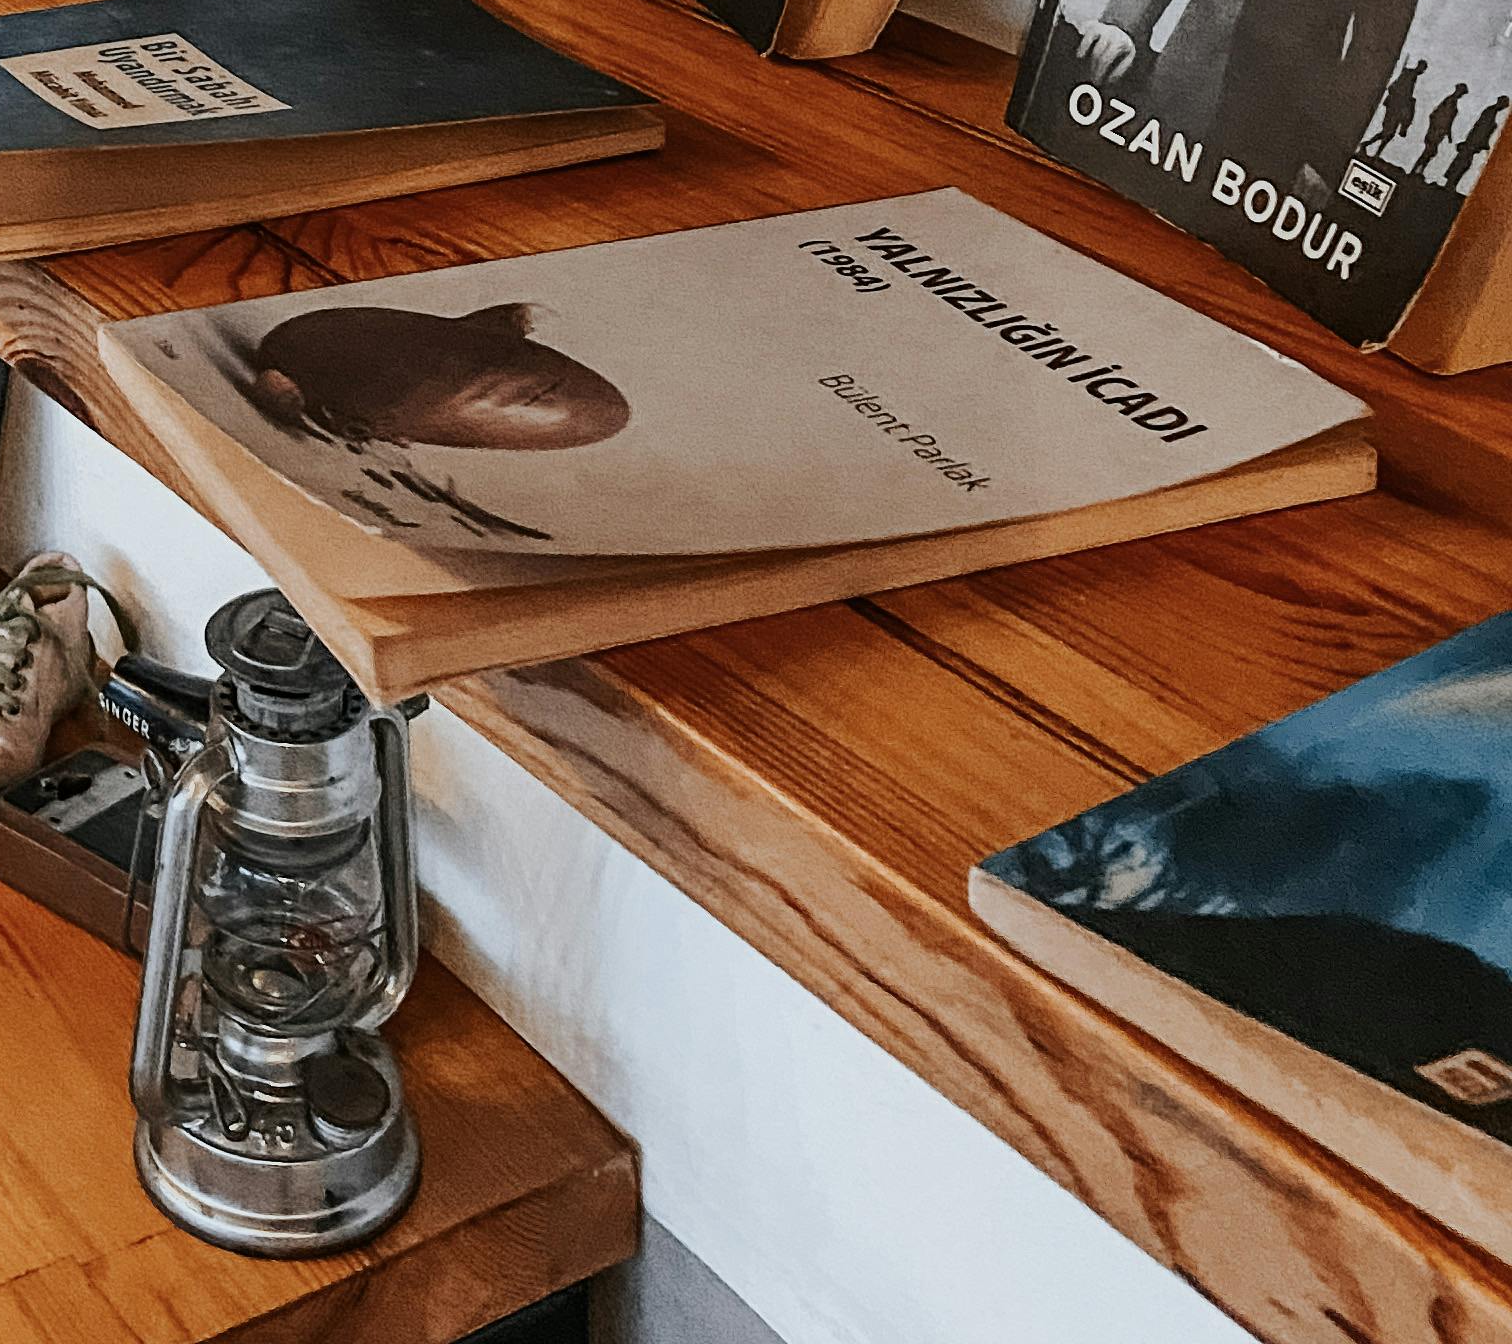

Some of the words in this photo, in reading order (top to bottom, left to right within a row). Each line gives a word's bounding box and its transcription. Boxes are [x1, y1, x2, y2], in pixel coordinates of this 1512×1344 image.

[97, 46, 224, 116] Uyandırmak
[139, 40, 189, 64] Bir
[172, 65, 260, 110] Sabahı
[1068, 84, 1203, 182] OZAN
[1211, 159, 1363, 280] BODUR
[1350, 174, 1384, 201] eşik
[798, 239, 891, 293] (1984)
[854, 226, 1090, 371] YALNIZLIĞIN
[1067, 363, 1208, 444] İCADI
[817, 373, 905, 439] Bülent
[903, 432, 990, 494] Parlak
[98, 691, 152, 739] SINGER
